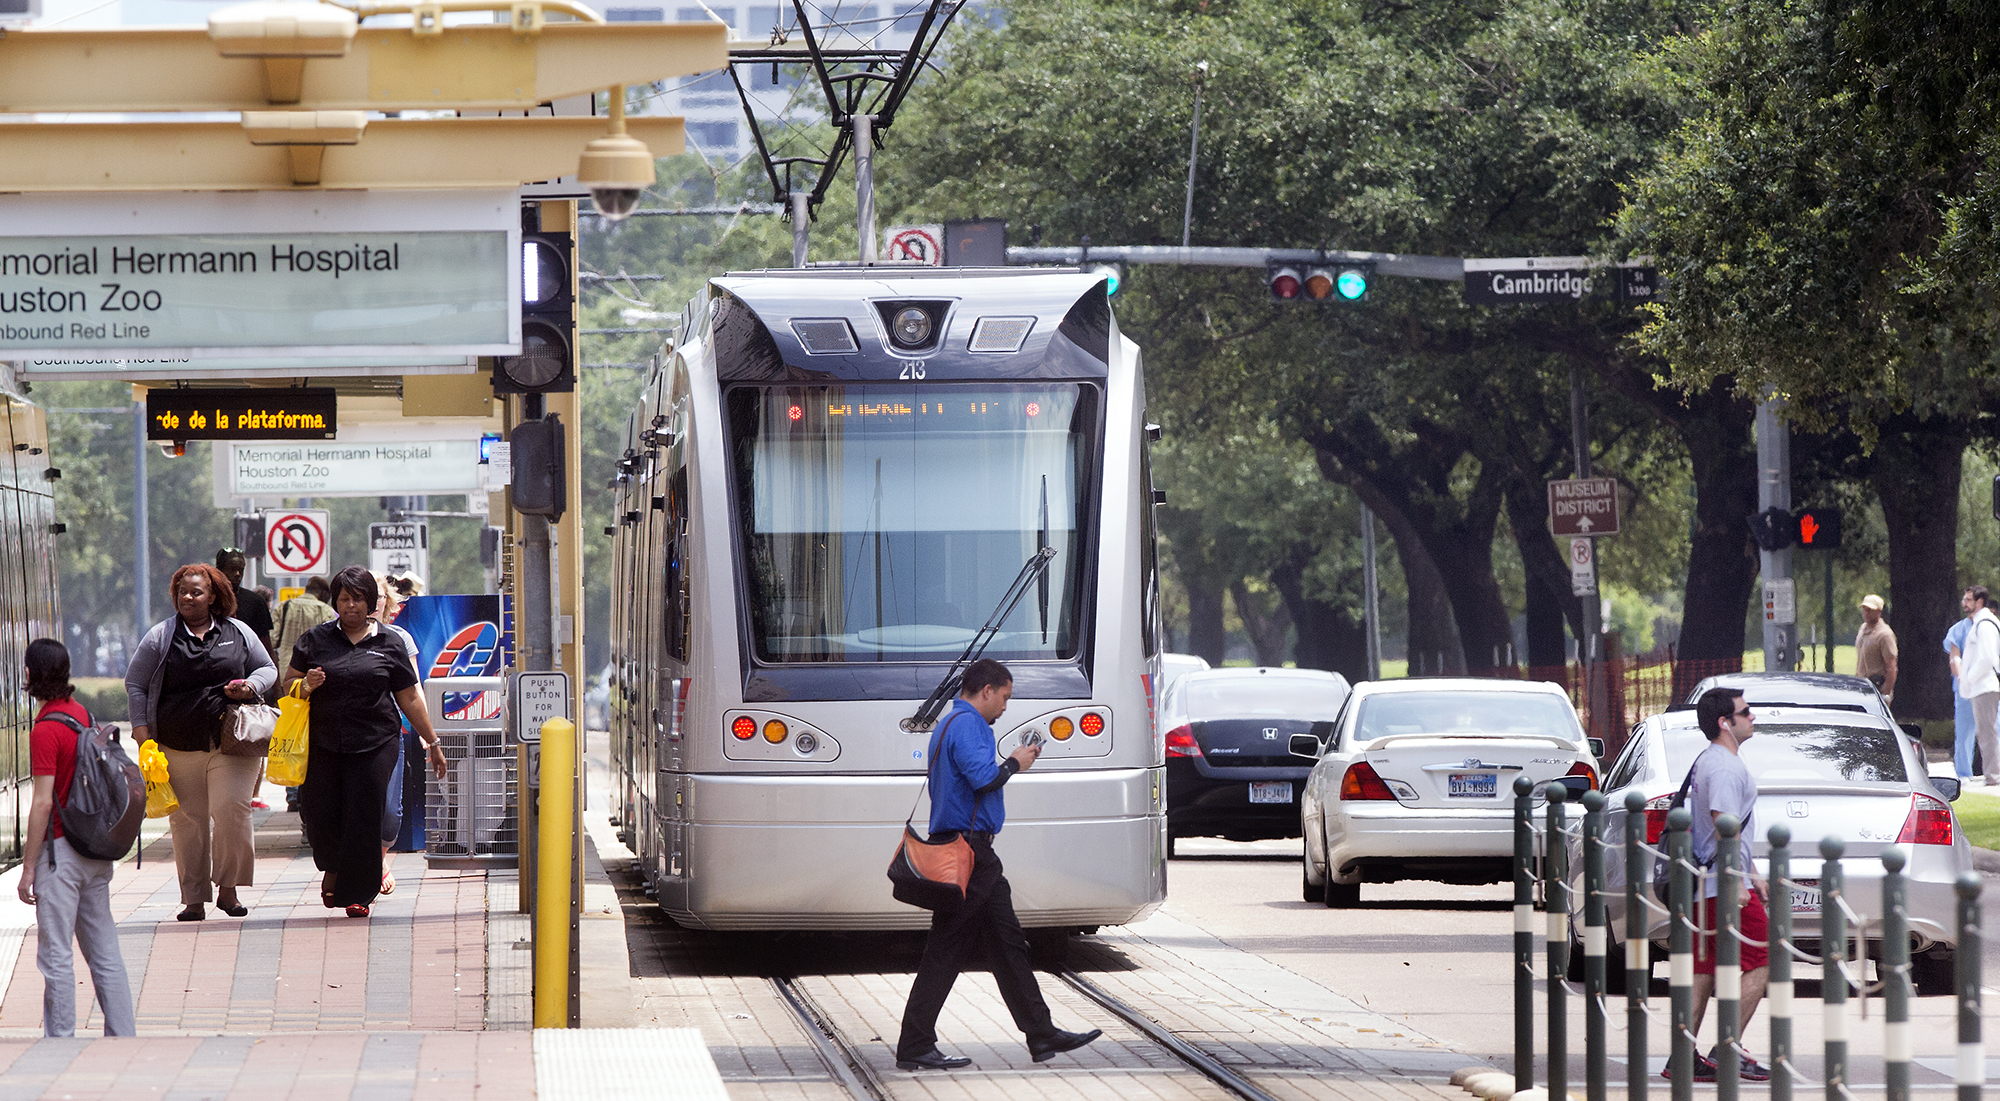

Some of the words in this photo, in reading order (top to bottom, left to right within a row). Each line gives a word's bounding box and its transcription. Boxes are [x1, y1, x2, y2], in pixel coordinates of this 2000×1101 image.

[0, 246, 97, 275] morial
[112, 246, 257, 274] Hermann
[271, 243, 399, 278] Hospital
[1492, 271, 1593, 298] Cambridge
[1634, 271, 1644, 282] St
[0, 286, 86, 312] uston
[100, 283, 162, 311] Zoo
[71, 323, 106, 339] Red
[113, 322, 150, 338] Line
[899, 360, 926, 380] 213
[189, 410, 206, 429] de
[216, 409, 229, 429] la
[238, 409, 326, 429] plataforma.
[239, 449, 302, 462] Memorial
[307, 447, 370, 461] Hermann
[375, 446, 432, 462] Hospital
[239, 465, 297, 478] Houston
[302, 464, 329, 477] Zoo
[239, 481, 289, 490] Southbound
[290, 481, 307, 489] Red
[309, 480, 326, 489] Line
[1555, 482, 1611, 498] MUSEUM
[1556, 498, 1611, 516] DISTRICT
[375, 538, 415, 549] SIGNA
[526, 691, 560, 699] BUTTON
[535, 703, 552, 711] FOR
[531, 715, 555, 723] WAL
[528, 727, 541, 735] SIG
